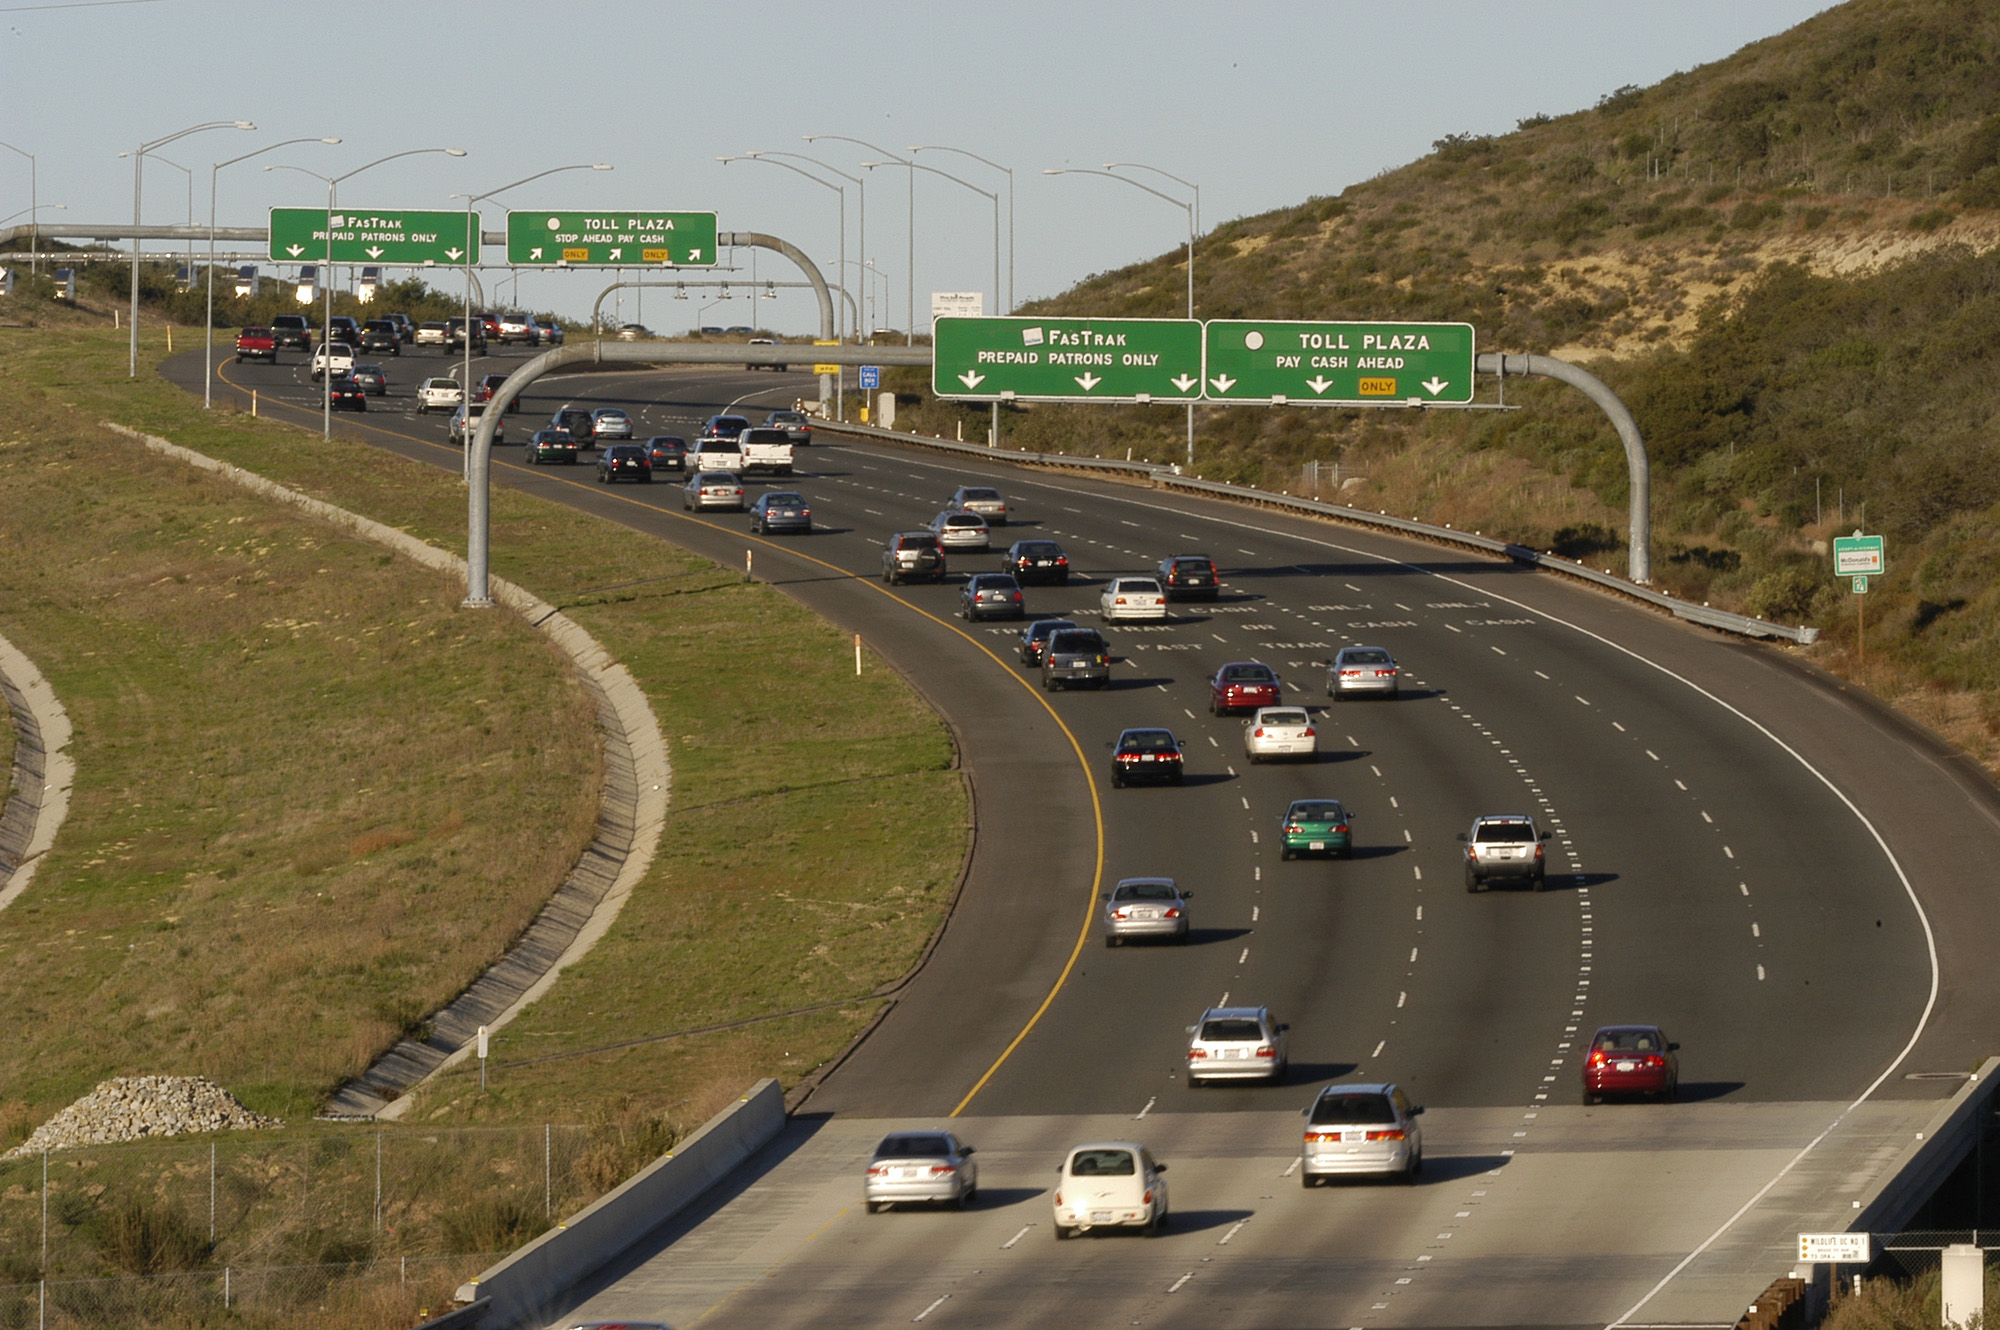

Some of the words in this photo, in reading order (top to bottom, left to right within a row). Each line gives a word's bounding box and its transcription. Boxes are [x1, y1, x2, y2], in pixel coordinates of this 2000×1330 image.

[584, 219, 619, 230] TOLL
[628, 219, 675, 231] PLAZA
[361, 232, 405, 242] PATRONS
[411, 234, 437, 243] ONLY
[555, 233, 579, 243] STOP
[582, 234, 613, 243] AHEAD
[618, 234, 635, 244] PAY
[640, 235, 665, 243] CASH
[644, 251, 667, 259] ONLY
[1299, 333, 1350, 349] TOLL
[1363, 334, 1430, 350] PLAZA
[978, 351, 1039, 364] PREPAID
[1049, 353, 1113, 365] PATRONS
[1122, 354, 1159, 366] ONLY
[1276, 356, 1301, 368] PAY
[1311, 356, 1348, 368] CASH
[1357, 357, 1405, 369] AHEAD
[1361, 382, 1393, 391] ONLY
[1189, 606, 1258, 614] CASH
[1307, 604, 1373, 612] ONLY
[1105, 625, 1175, 633] TRAK
[1347, 620, 1418, 628] CASH
